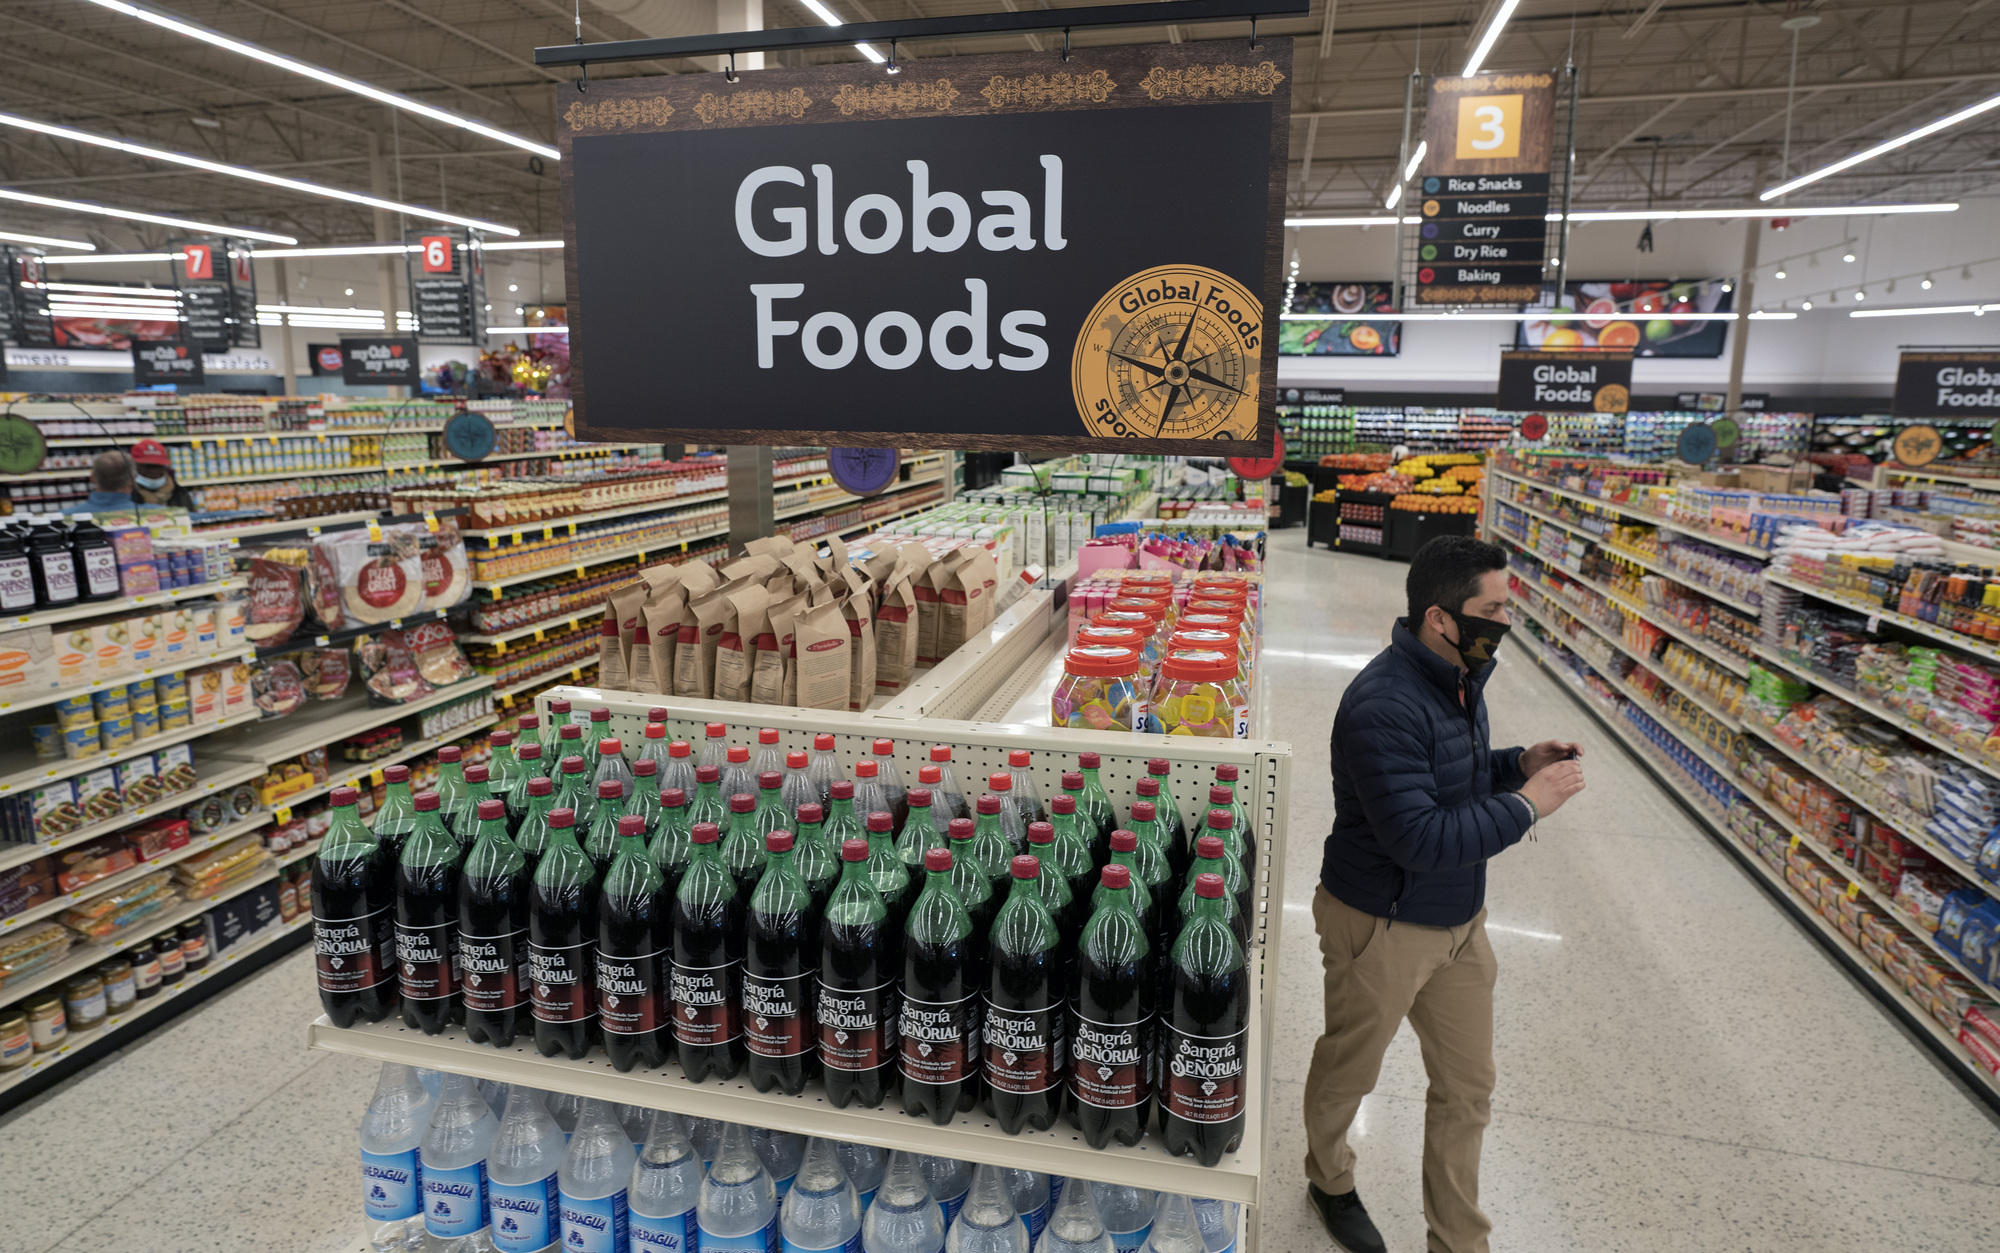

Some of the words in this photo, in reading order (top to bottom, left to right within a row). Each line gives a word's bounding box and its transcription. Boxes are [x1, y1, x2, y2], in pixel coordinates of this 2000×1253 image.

[1471, 105, 1505, 150] 3
[1448, 179, 1475, 191] Rice
[1478, 177, 1522, 191] Snacks
[734, 154, 1068, 258] Global
[1457, 201, 1511, 214] Noodles
[1463, 224, 1500, 239] Curry
[189, 250, 204, 273] 7
[427, 240, 444, 266] 6
[1454, 246, 1476, 260] Dry
[1480, 245, 1508, 258] Rice
[1457, 269, 1501, 284] Baking
[749, 278, 1050, 372] Foods
[1119, 279, 1200, 314] Global
[1204, 285, 1260, 350] Foods
[1093, 343, 1104, 352] W
[1532, 364, 1597, 384] Global
[1936, 366, 2000, 387] Globa
[1535, 385, 1592, 402] Foods
[368, 566, 395, 579] PIZZA
[368, 577, 396, 593] CRUST
[819, 989, 866, 1015] Sangría
[901, 1000, 951, 1027] Sangría
[816, 1002, 877, 1028] SEÑORIAL
[898, 1013, 961, 1040] SEÑORIAL
[986, 1008, 1036, 1036] Sangría
[982, 1021, 1047, 1049] SEÑORIAL
[1078, 1022, 1132, 1049] Sangría
[1072, 1036, 1142, 1063] SEÑORIAL
[1179, 1039, 1236, 1063] Sangría
[1170, 1053, 1243, 1078] SEÑORIAL
